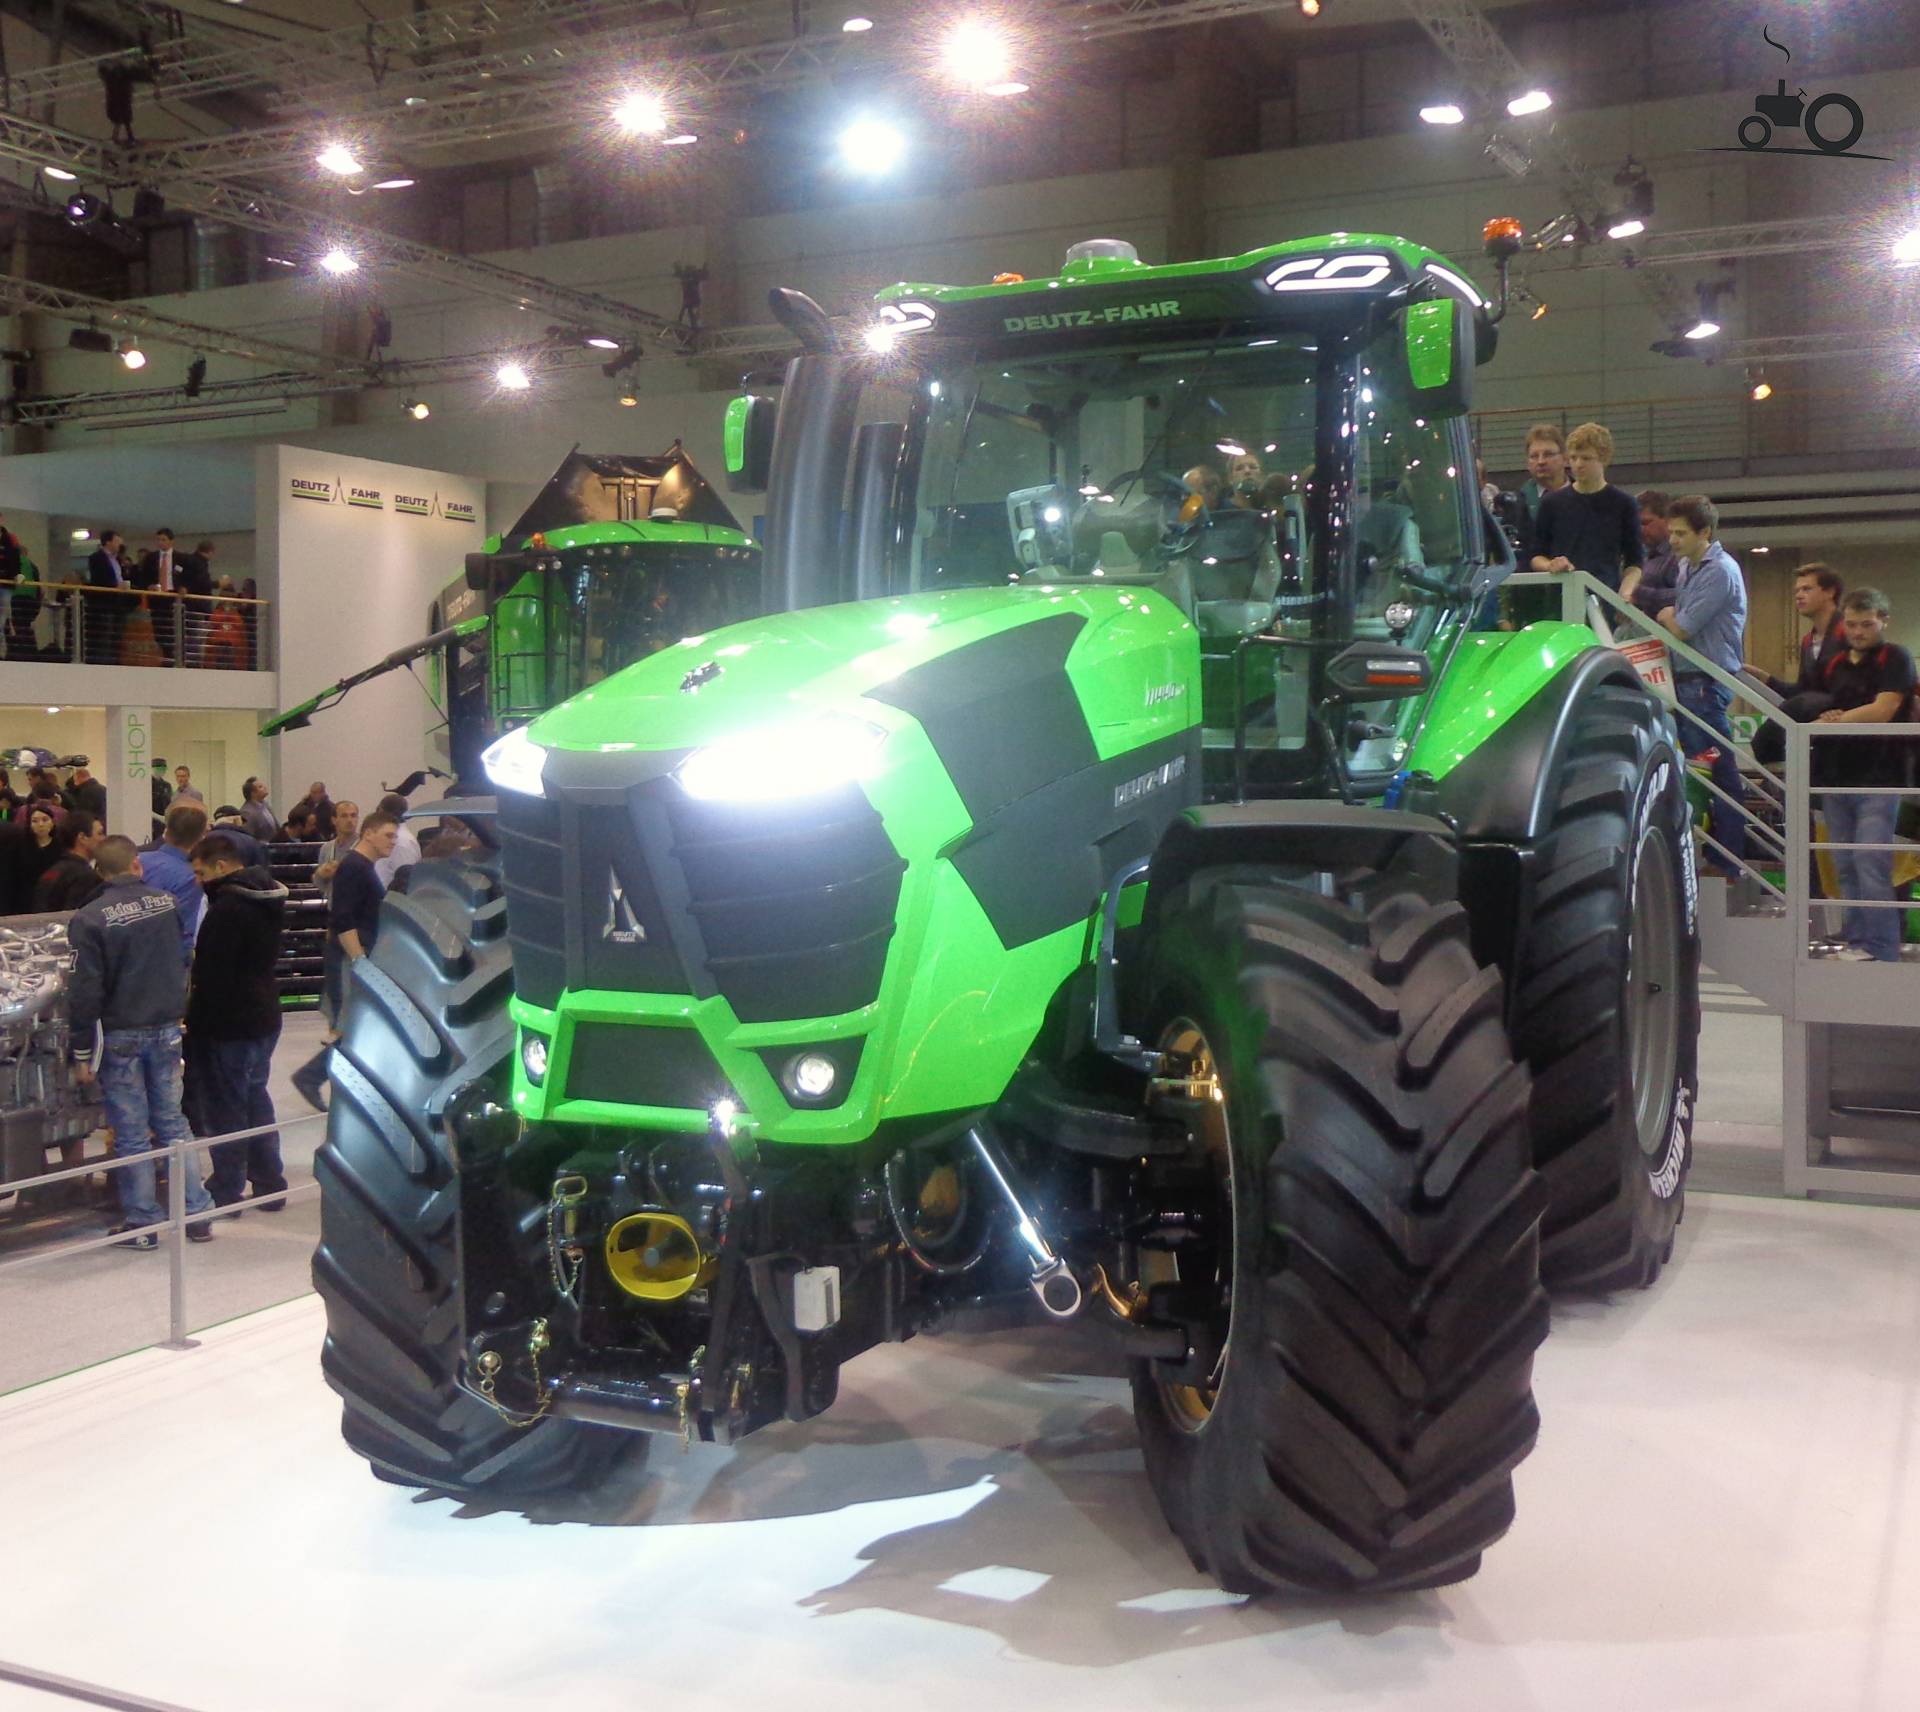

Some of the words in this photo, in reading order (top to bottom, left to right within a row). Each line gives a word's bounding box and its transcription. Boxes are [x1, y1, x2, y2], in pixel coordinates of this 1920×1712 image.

[1003, 300, 1181, 332] DEUTZ-FAHR
[291, 479, 330, 493] DEUTZ
[351, 488, 380, 500] FAHR
[395, 495, 428, 507] DEUTZ
[447, 502, 473, 514] FAHR
[128, 714, 146, 778] SHOP
[102, 901, 142, 920] Eden
